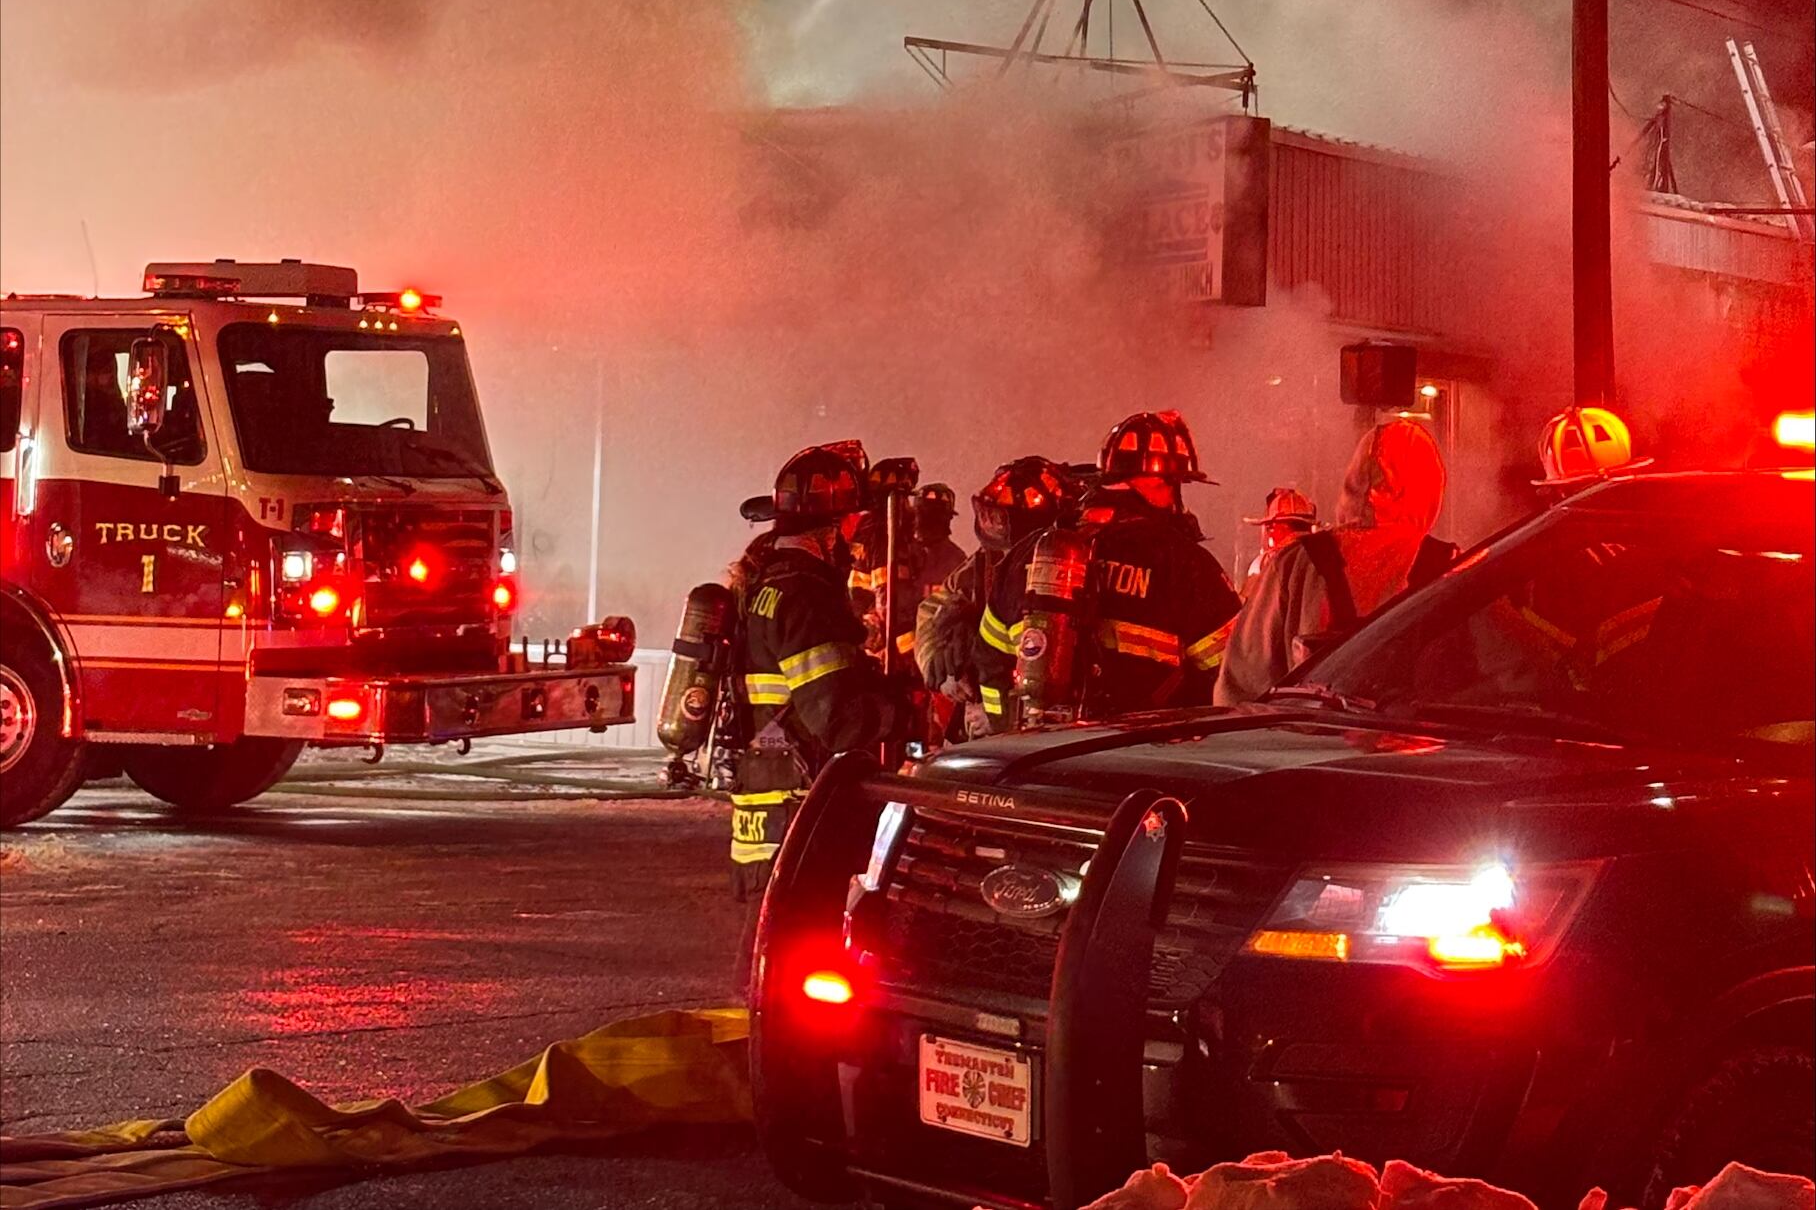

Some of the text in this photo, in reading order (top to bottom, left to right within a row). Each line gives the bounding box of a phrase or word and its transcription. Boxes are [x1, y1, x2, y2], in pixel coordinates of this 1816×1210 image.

[259, 498, 284, 520] T-1
[95, 522, 206, 547] TRUCK
[140, 554, 155, 593] 1
[956, 790, 1016, 809] SETINA
[993, 873, 1041, 903] Ford
[926, 1068, 1026, 1112] FIRE CHIEF
[936, 1101, 1015, 1133] CONNECTICUT
